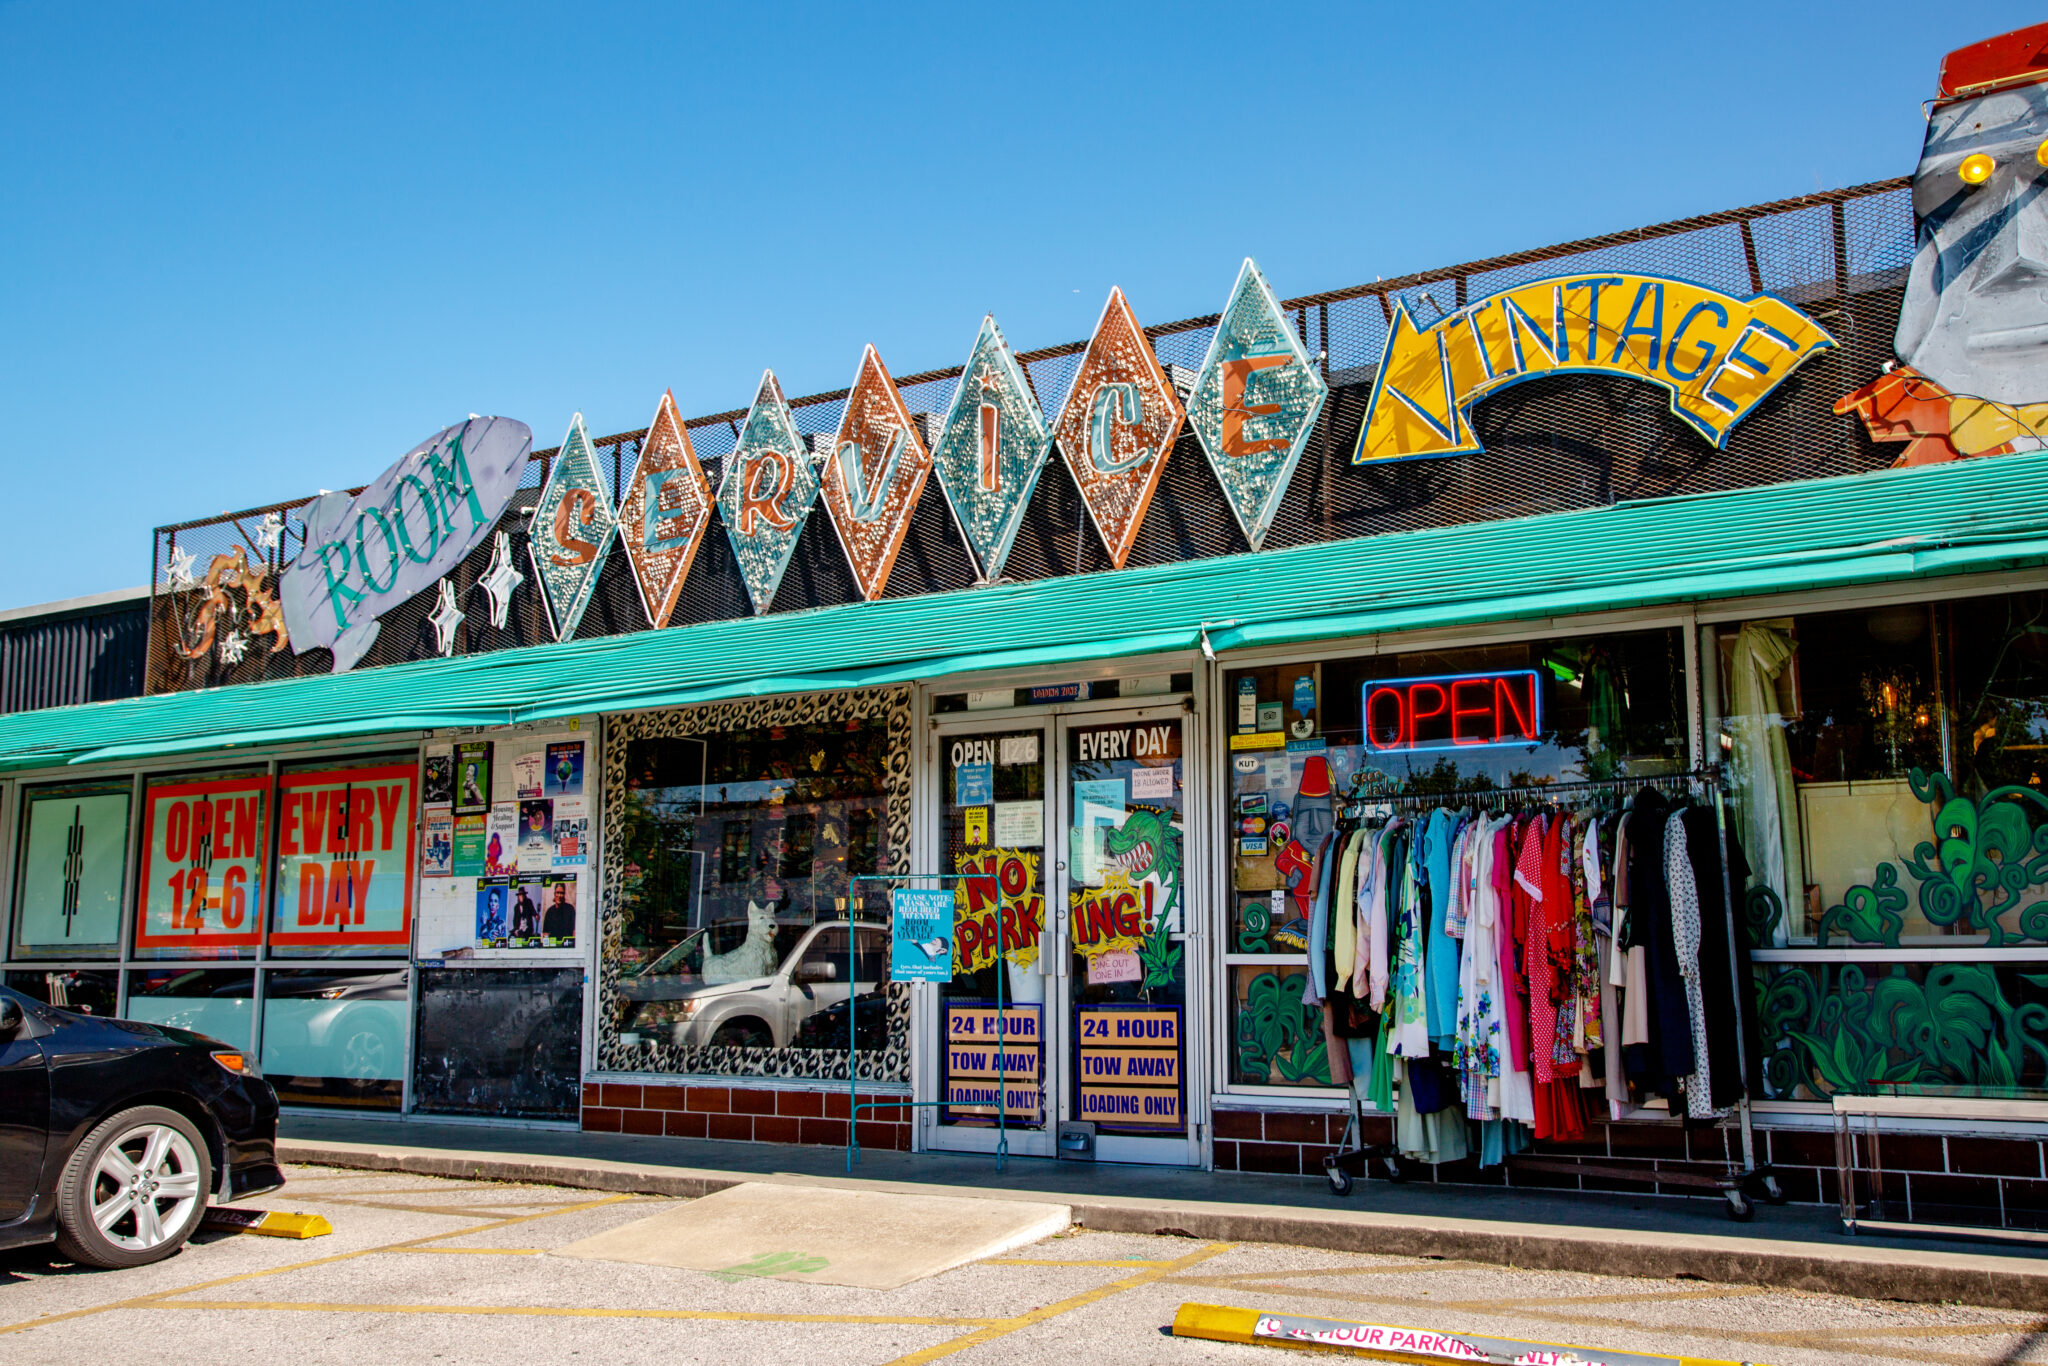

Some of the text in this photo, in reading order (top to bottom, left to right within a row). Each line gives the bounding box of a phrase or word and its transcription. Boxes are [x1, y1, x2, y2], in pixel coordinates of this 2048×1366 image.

[1386, 277, 1800, 446] VINTAGE
[551, 354, 1294, 568] SERVICE
[314, 434, 491, 632] ROOM
[1031, 686, 1078, 699] LOADING ZONE
[1367, 674, 1536, 750] OPEN
[951, 739, 995, 768] OPEN
[1079, 726, 1171, 761] EVERY DAY
[1143, 778, 1169, 786] ALLOWED
[1352, 771, 1382, 787] open
[1365, 776, 1398, 796] daily
[166, 796, 259, 862] OPEN
[280, 785, 402, 856] EVERY
[297, 860, 375, 928] DAY
[961, 854, 1027, 914] NO
[167, 864, 247, 930] 12-6
[897, 893, 952, 902] PLEASE NOTE:
[903, 899, 947, 908] MASKS ARE
[1073, 880, 1154, 946] ING!
[897, 931, 931, 939] VINTAGE
[900, 925, 934, 933] SERVICE
[955, 896, 1040, 969] PARK
[1095, 959, 1129, 969] ONE OUT
[1095, 969, 1123, 980] ONE IN
[951, 1016, 1036, 1036] 24 HOUR
[1083, 1018, 1174, 1039] 24 HOUR
[951, 1052, 1036, 1072] TOW AWAY
[1083, 1056, 1175, 1077] TOW AWAY
[950, 1087, 1036, 1109] LOADING ONLY
[1082, 1093, 1176, 1116] LOADING ONLY
[1388, 1329, 1488, 1359] PARKIN
[1517, 1350, 1561, 1366] NLY
